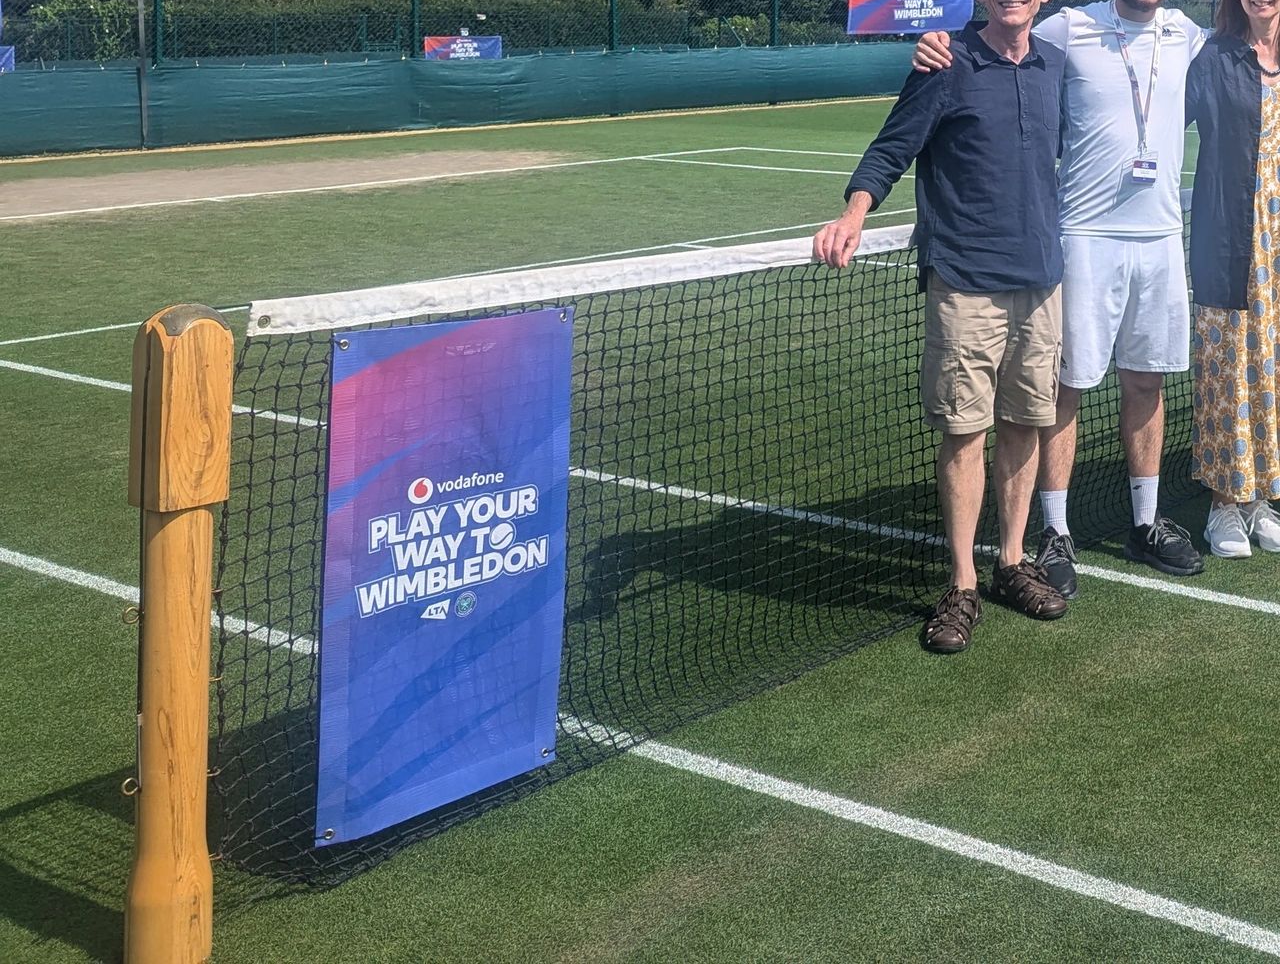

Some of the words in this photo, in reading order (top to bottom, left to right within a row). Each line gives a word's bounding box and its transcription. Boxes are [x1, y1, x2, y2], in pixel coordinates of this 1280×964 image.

[894, 6, 943, 20] WIMBLEDON
[904, 0, 922, 8] WAY
[923, 0, 934, 8] TO
[437, 472, 504, 493] vodafone
[371, 505, 449, 550] PLAY
[453, 487, 537, 528] YOUR
[394, 531, 466, 570] WAY
[470, 522, 514, 554] TO
[358, 537, 548, 614] WIMBLEDON
[428, 605, 448, 616] LTA
